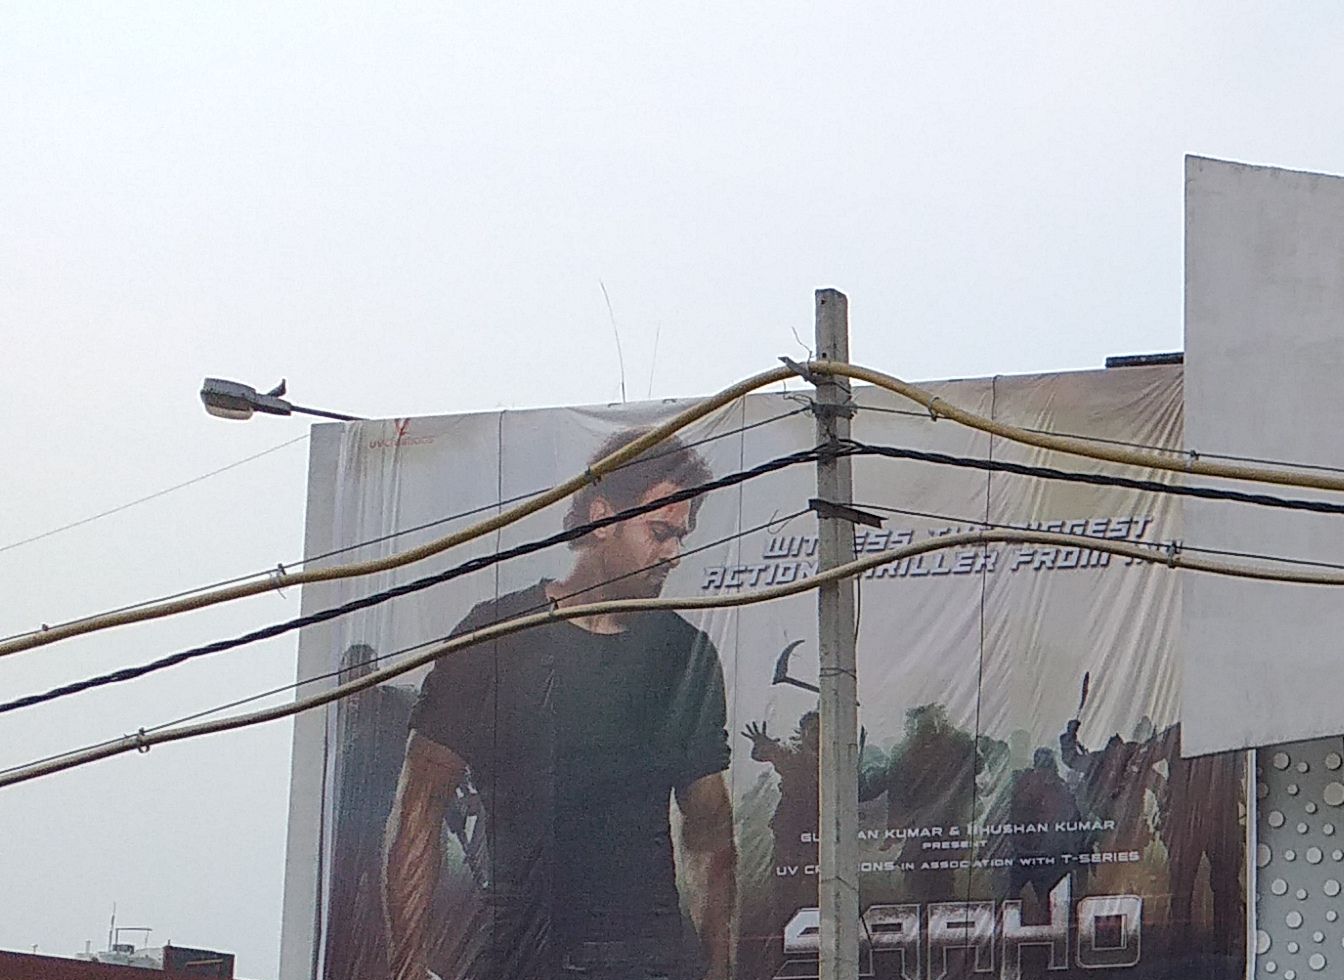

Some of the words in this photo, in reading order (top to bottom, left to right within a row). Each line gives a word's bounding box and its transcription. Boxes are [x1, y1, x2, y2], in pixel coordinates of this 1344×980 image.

[763, 528, 913, 559] WITESS
[860, 548, 999, 581] RILLER
[1011, 545, 1112, 572] FROM
[885, 826, 943, 839] KUMAR
[1055, 819, 1115, 832] KUMAR
[776, 866, 799, 876] UV
[901, 861, 914, 870] IN
[1020, 857, 1055, 867] WITH
[1061, 850, 1140, 863] T-SERIES
